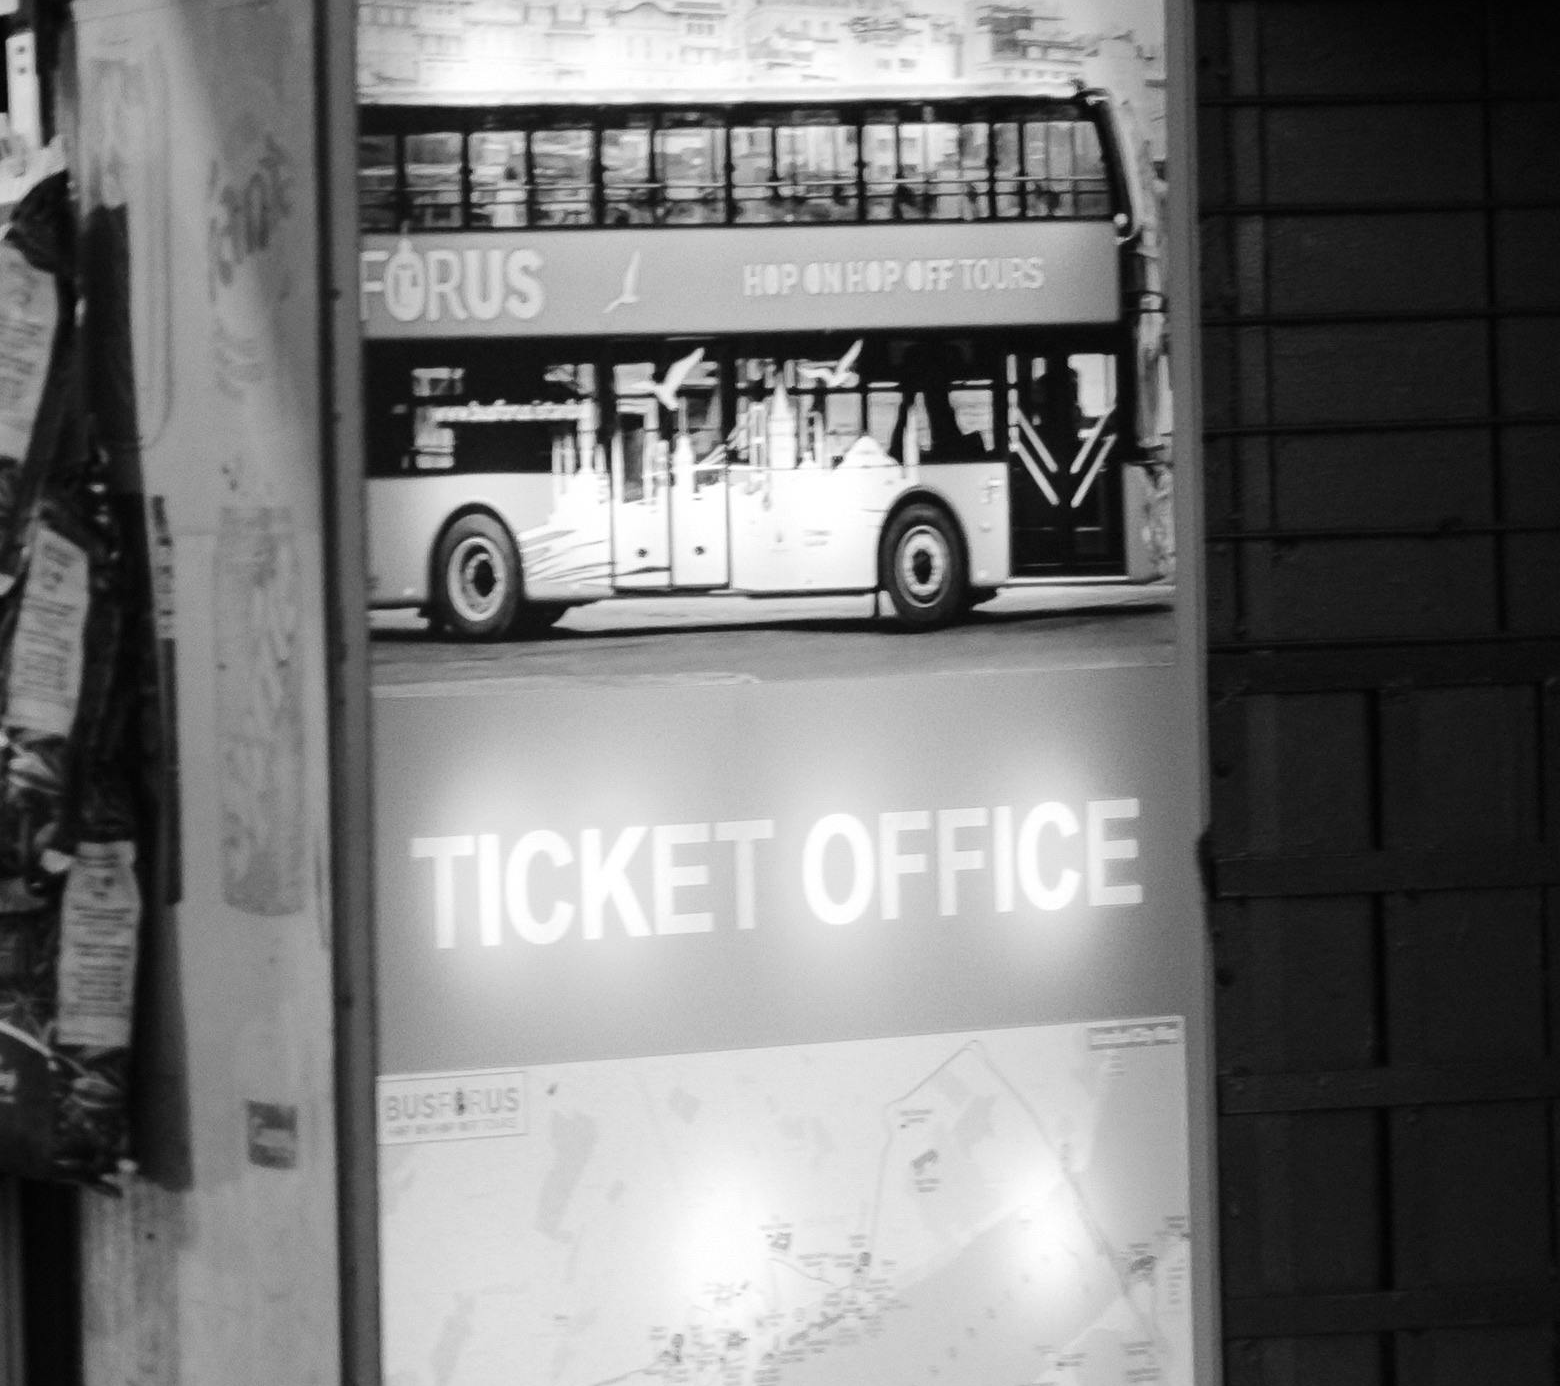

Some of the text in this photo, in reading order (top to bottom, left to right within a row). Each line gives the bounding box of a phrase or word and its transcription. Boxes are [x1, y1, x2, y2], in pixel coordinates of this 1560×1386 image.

[743, 258, 797, 299] HOP
[845, 258, 902, 295] HOP
[906, 256, 954, 293] OFF
[959, 255, 1046, 294] TOURS
[410, 797, 1144, 951] TICKET OFFICE
